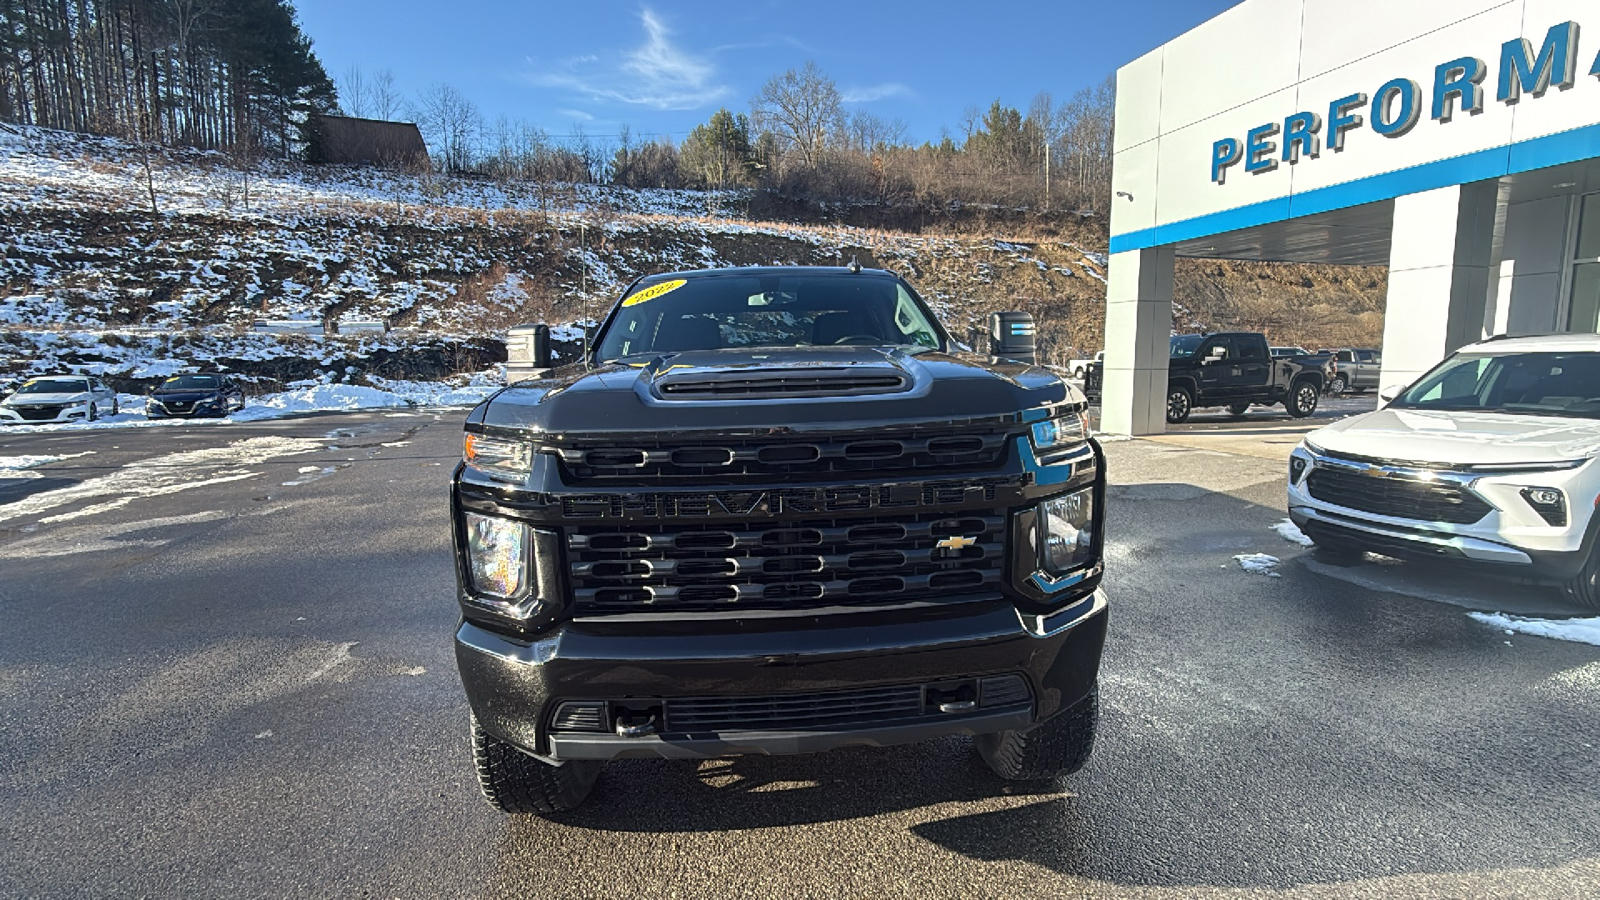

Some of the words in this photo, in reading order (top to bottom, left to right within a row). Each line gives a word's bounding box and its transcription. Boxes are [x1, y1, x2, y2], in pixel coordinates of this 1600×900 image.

[1211, 20, 1600, 185] PERFORM
[634, 282, 677, 302] 2022
[562, 478, 1008, 518] CHEVROLET
